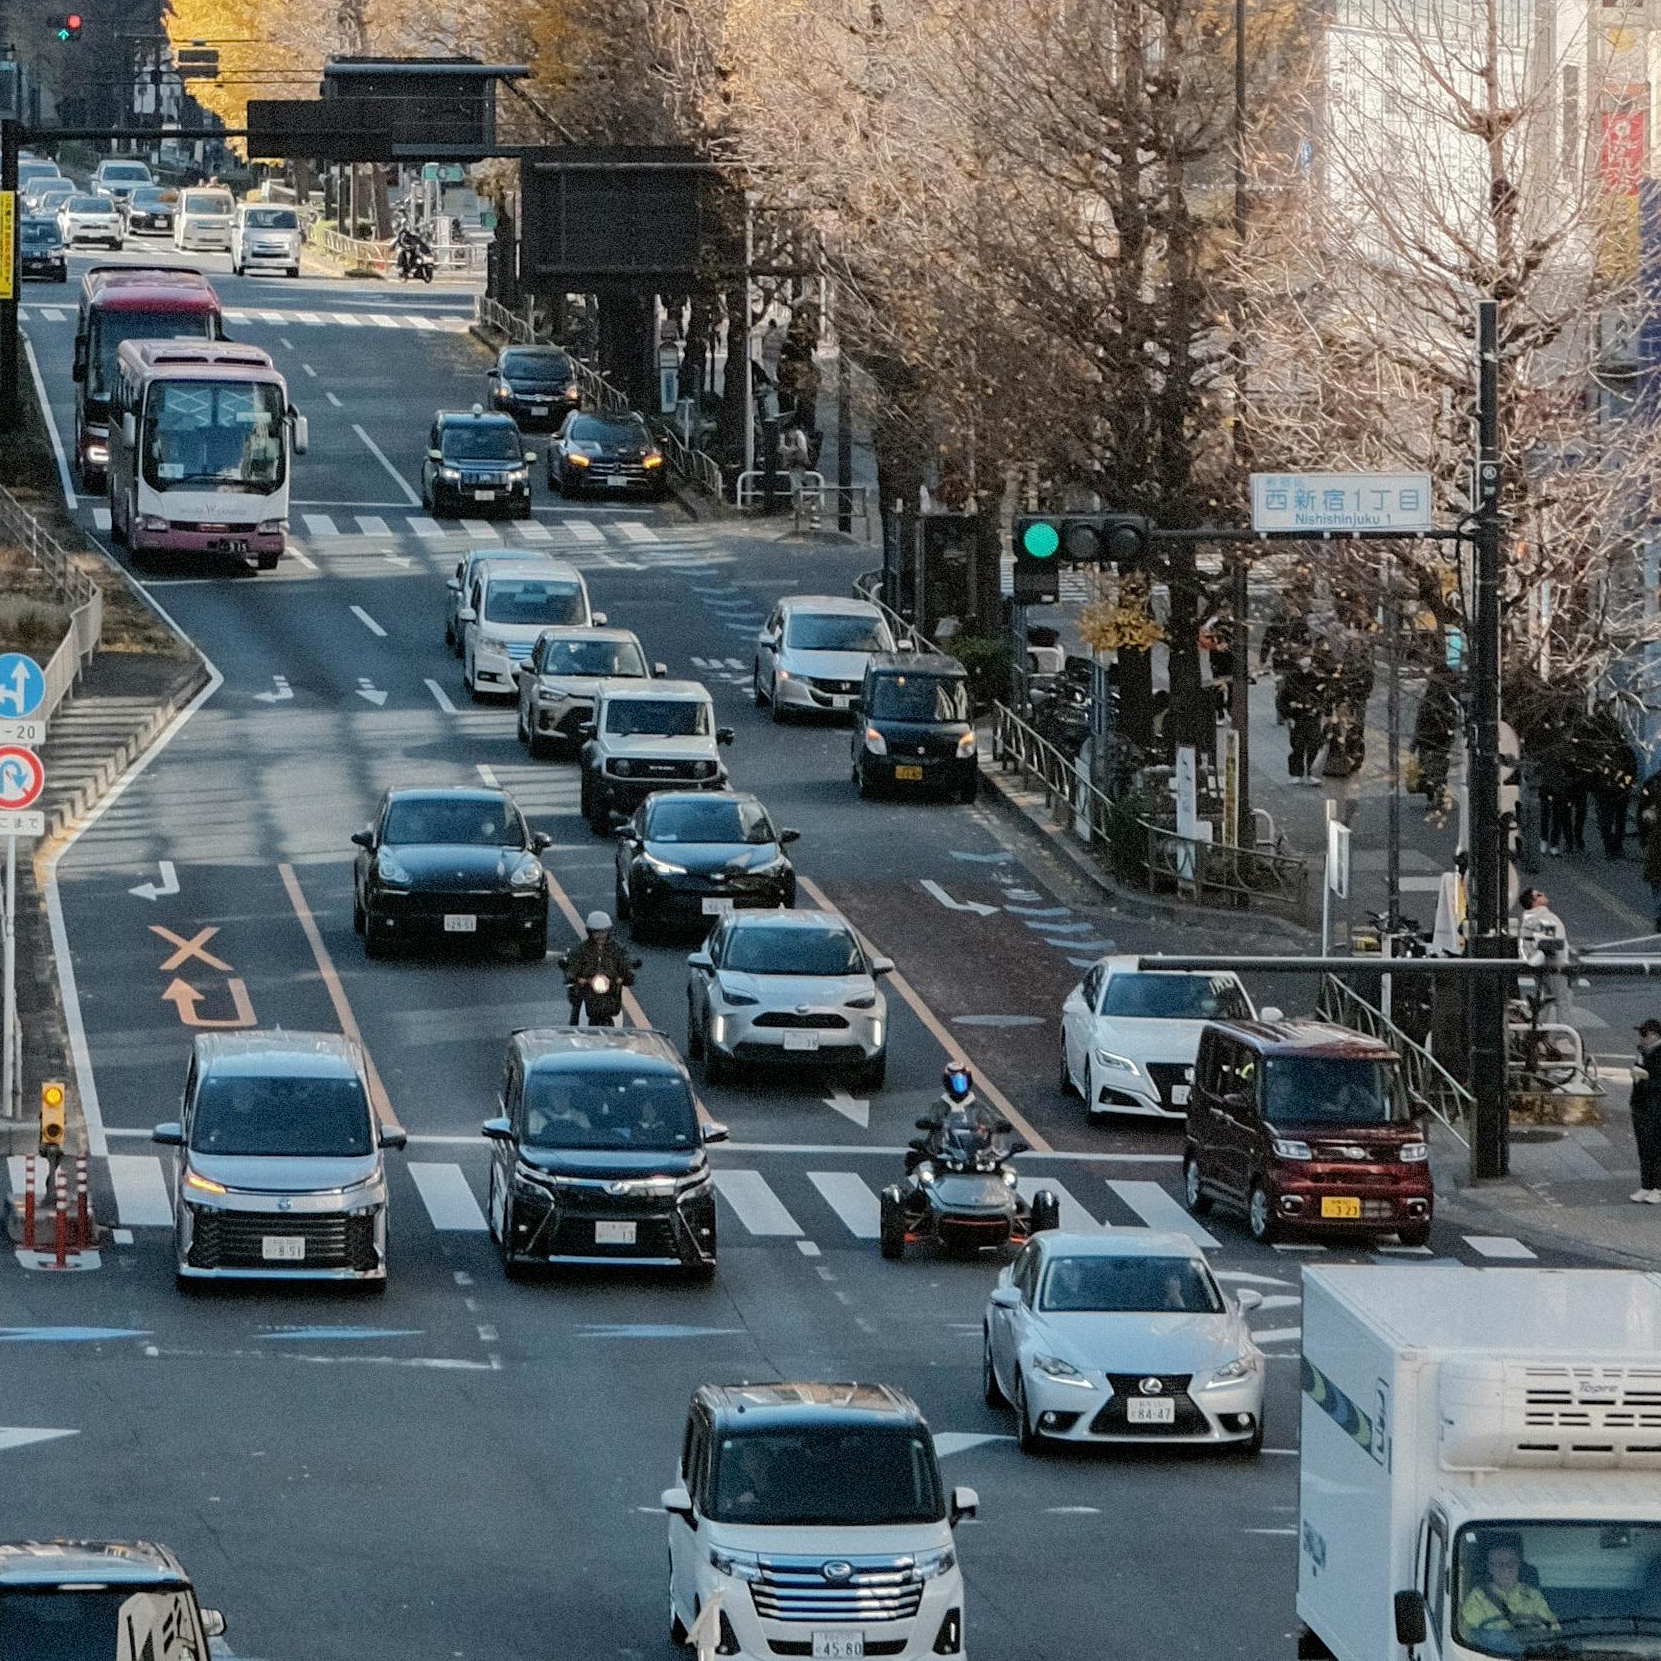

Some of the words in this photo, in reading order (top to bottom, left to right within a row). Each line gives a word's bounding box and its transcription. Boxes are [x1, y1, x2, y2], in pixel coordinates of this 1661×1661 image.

[1265, 488, 1420, 512] 西新宿1丁目
[1295, 513, 1381, 527] Nishishinjuku
